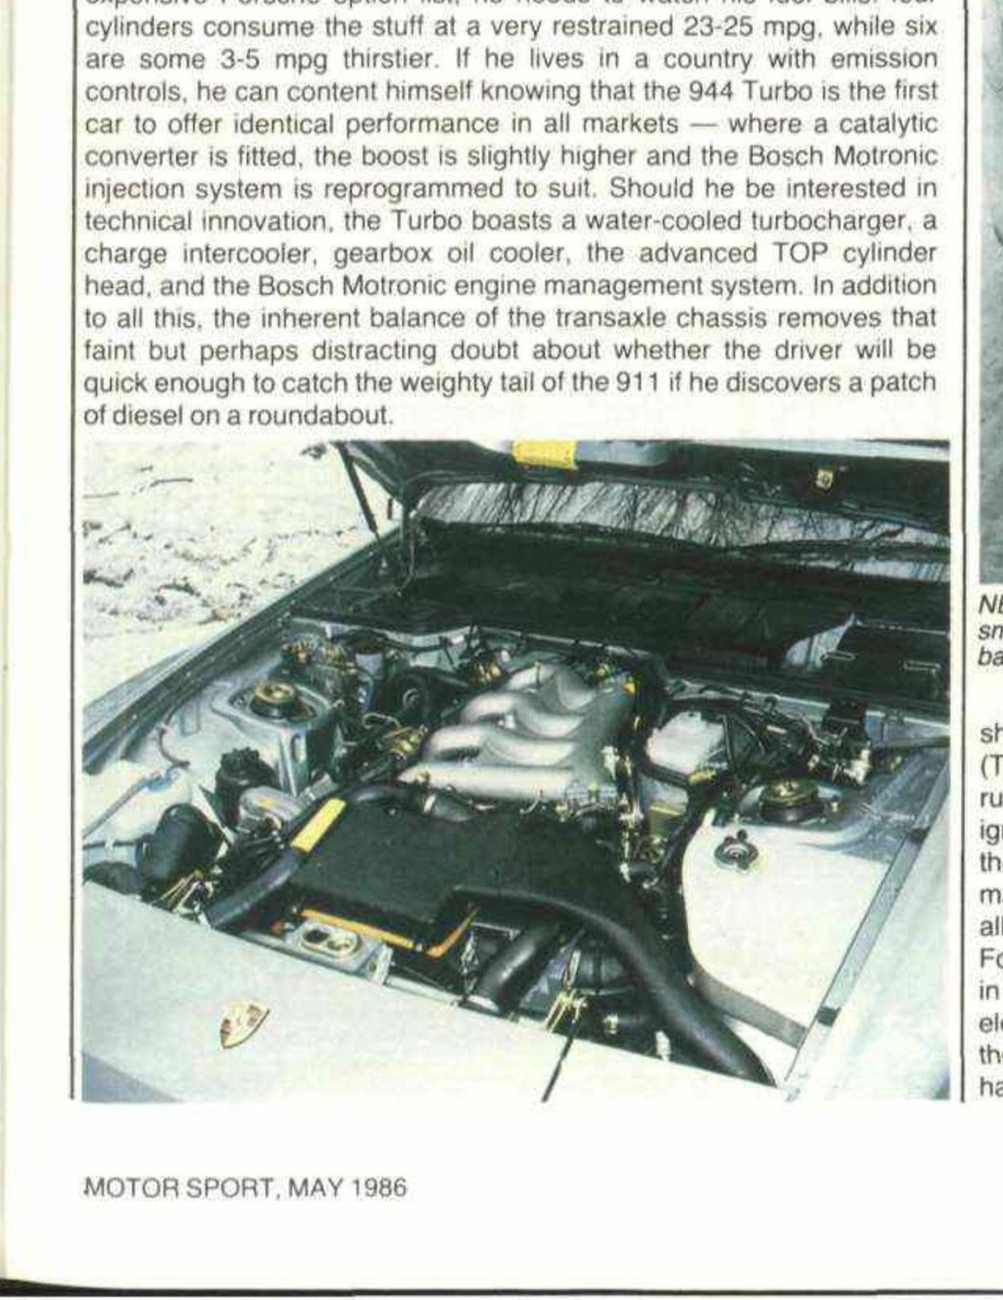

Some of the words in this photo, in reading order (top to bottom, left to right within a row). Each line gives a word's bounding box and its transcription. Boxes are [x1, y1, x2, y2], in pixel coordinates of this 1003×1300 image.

[83, 1176, 180, 1199] MOTOR
[187, 1177, 281, 1200] SPORT,
[289, 1177, 344, 1199] MAY
[353, 1177, 408, 1199] 1986
